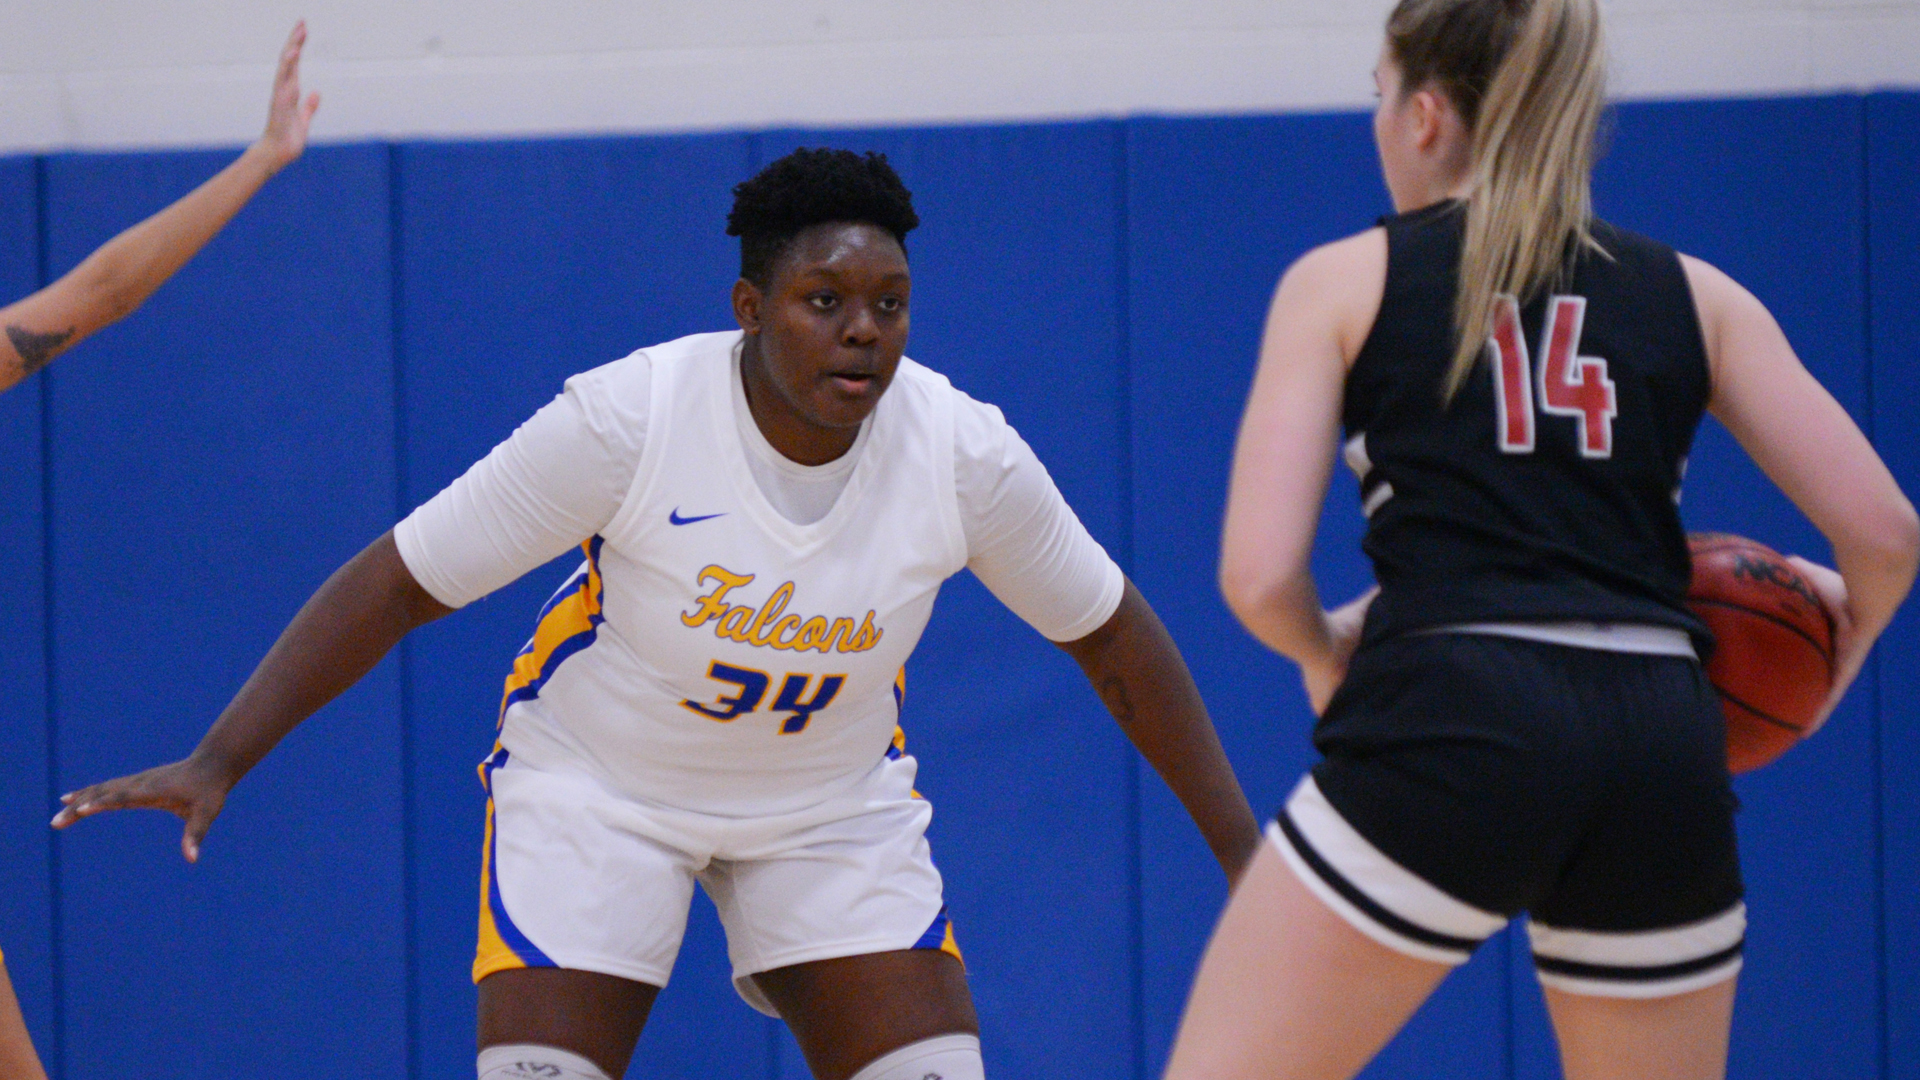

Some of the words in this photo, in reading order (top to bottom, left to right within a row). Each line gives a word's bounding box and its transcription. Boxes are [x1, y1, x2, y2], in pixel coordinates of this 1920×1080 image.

[1488, 293, 1618, 459] 14
[680, 564, 884, 654] Falcons
[677, 658, 849, 736] 34
